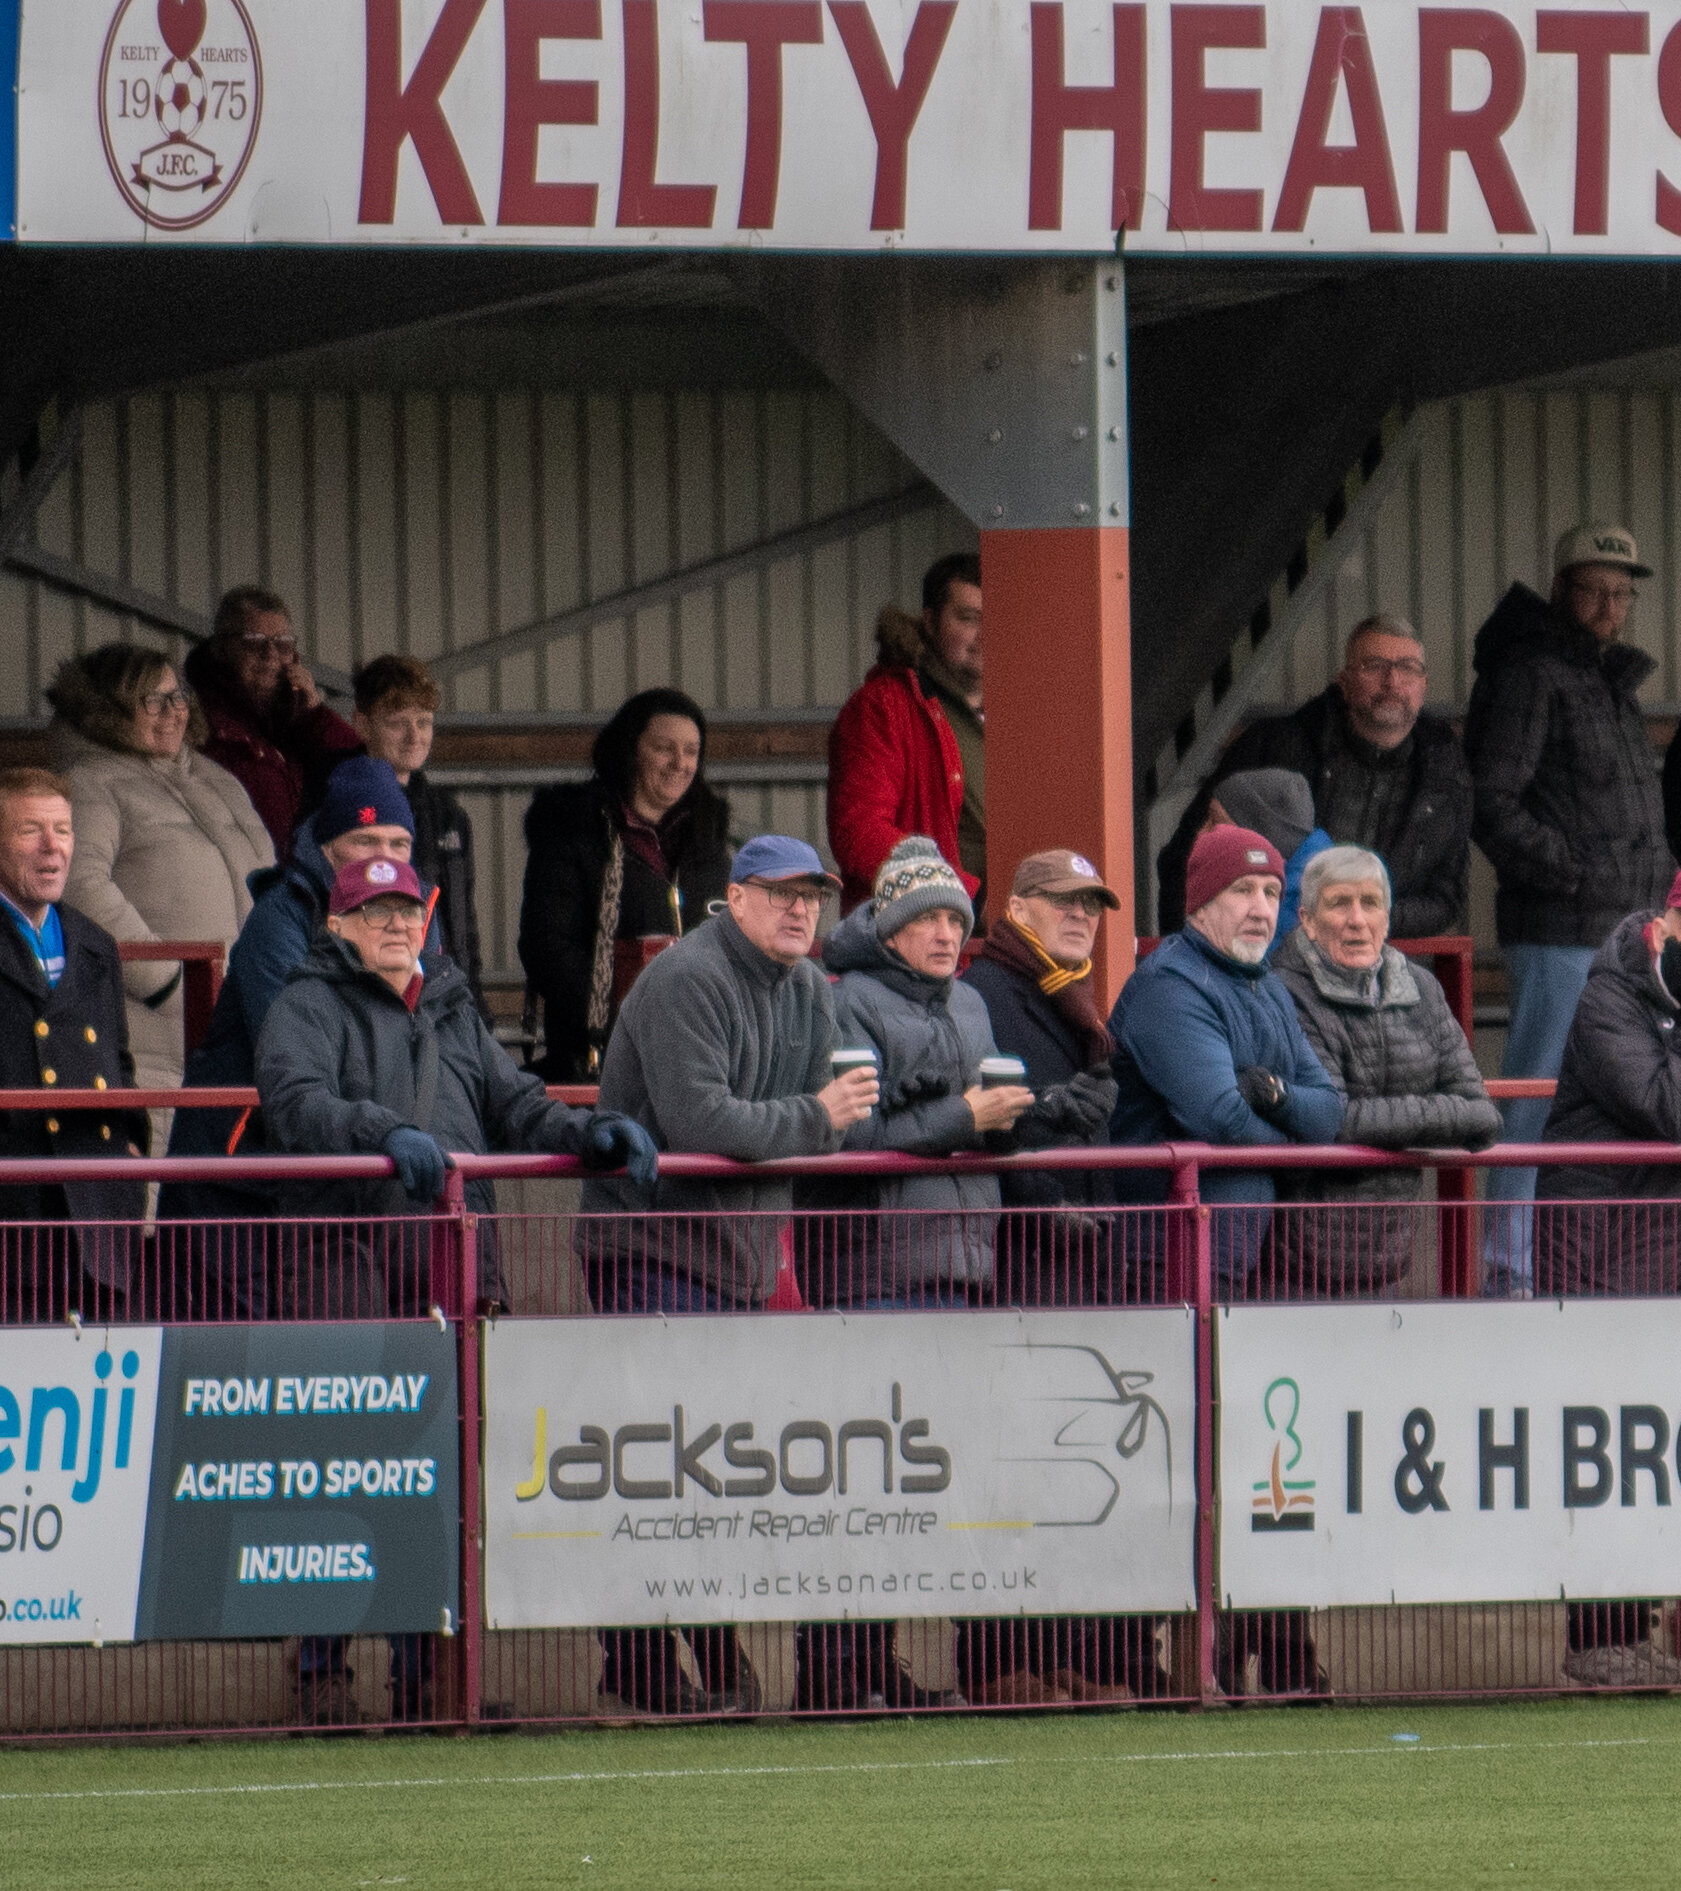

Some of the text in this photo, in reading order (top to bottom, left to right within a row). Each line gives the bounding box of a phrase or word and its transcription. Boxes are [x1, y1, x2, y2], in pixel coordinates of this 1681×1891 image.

[121, 45, 248, 63] KELTY HEARTS
[118, 79, 247, 120] 19 75
[357, 0, 959, 231] KELTY
[156, 154, 199, 176] J.F.C.
[185, 1374, 429, 1416] FROM EVERYDAY
[516, 1382, 952, 1501] Jackson's
[1346, 1410, 1364, 1514] I
[1394, 1407, 1451, 1514] &
[1478, 1407, 1530, 1510] H
[174, 1458, 437, 1500] ACHES TO SPORTS
[612, 1507, 938, 1544] Accident Repair Centre
[238, 1543, 376, 1584] INJURIES.
